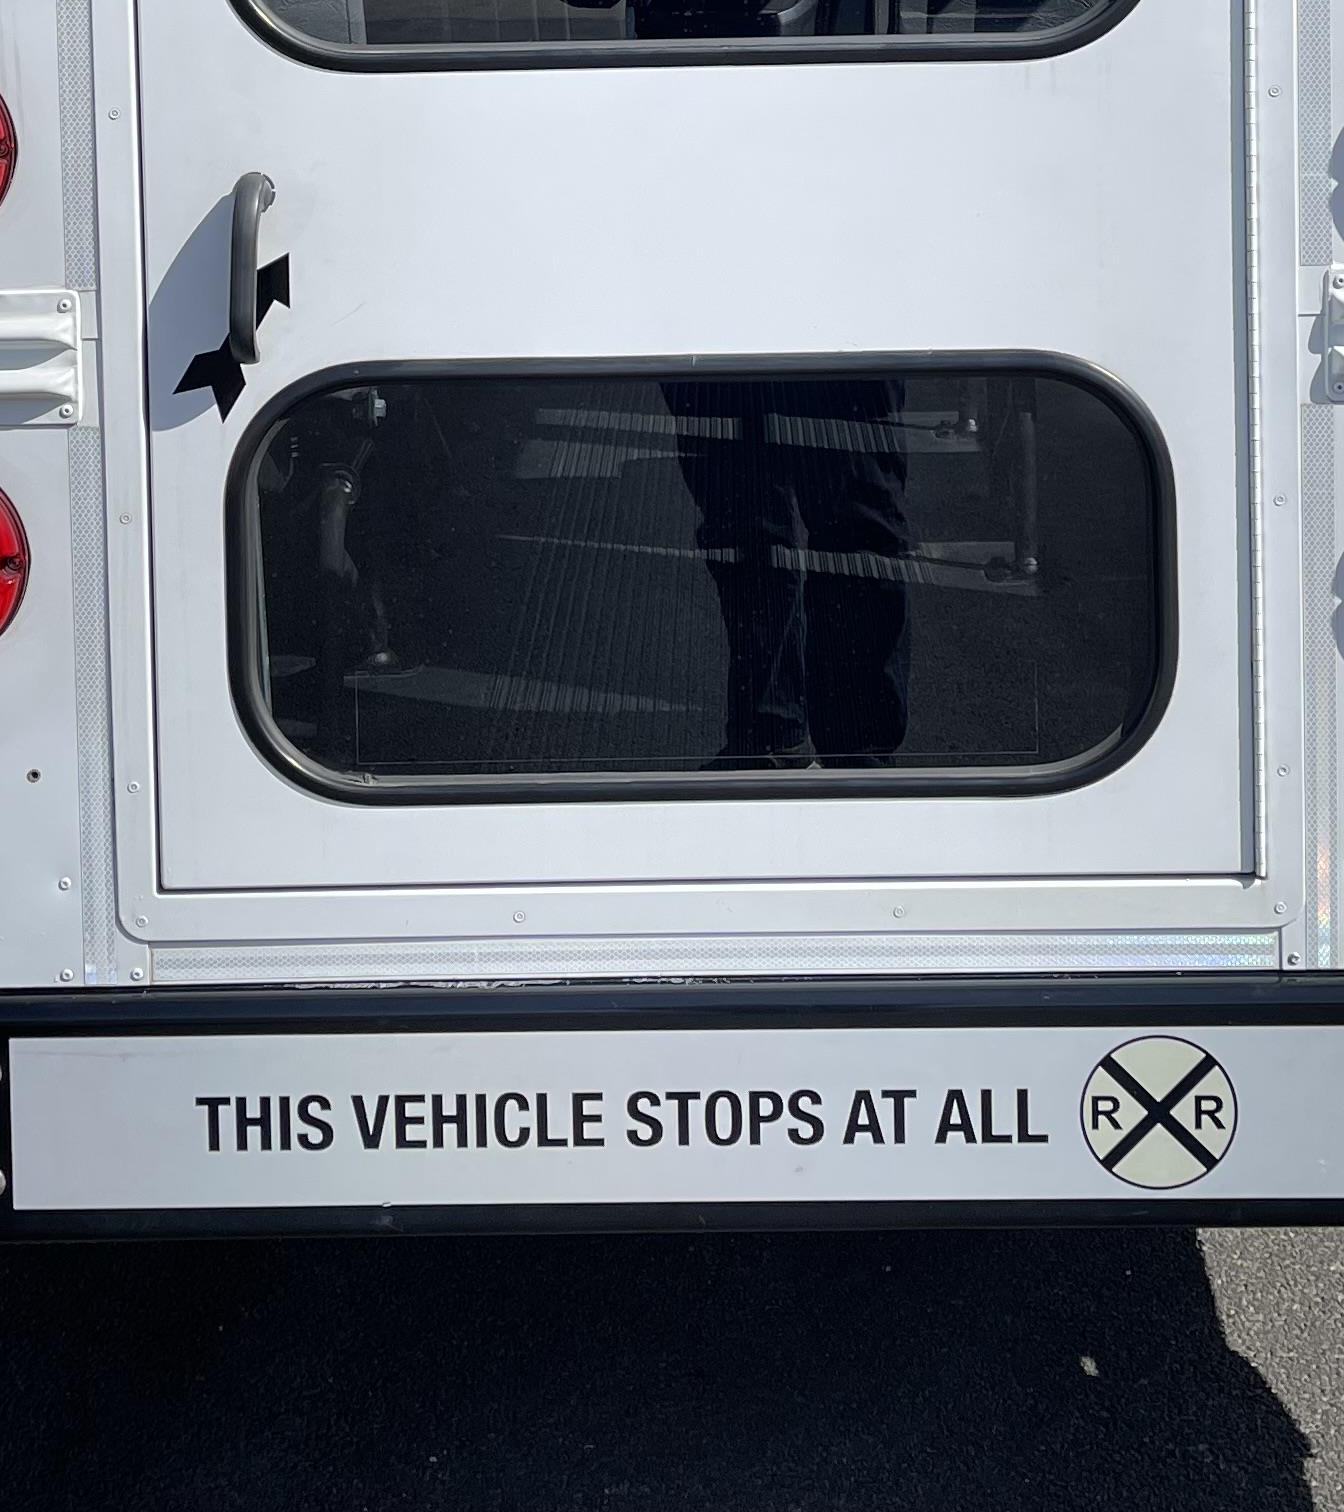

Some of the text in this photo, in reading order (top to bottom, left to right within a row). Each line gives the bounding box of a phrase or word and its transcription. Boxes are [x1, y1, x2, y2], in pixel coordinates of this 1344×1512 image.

[195, 1088, 1049, 1152] THIS VEHICLE STOPS AT ALL
